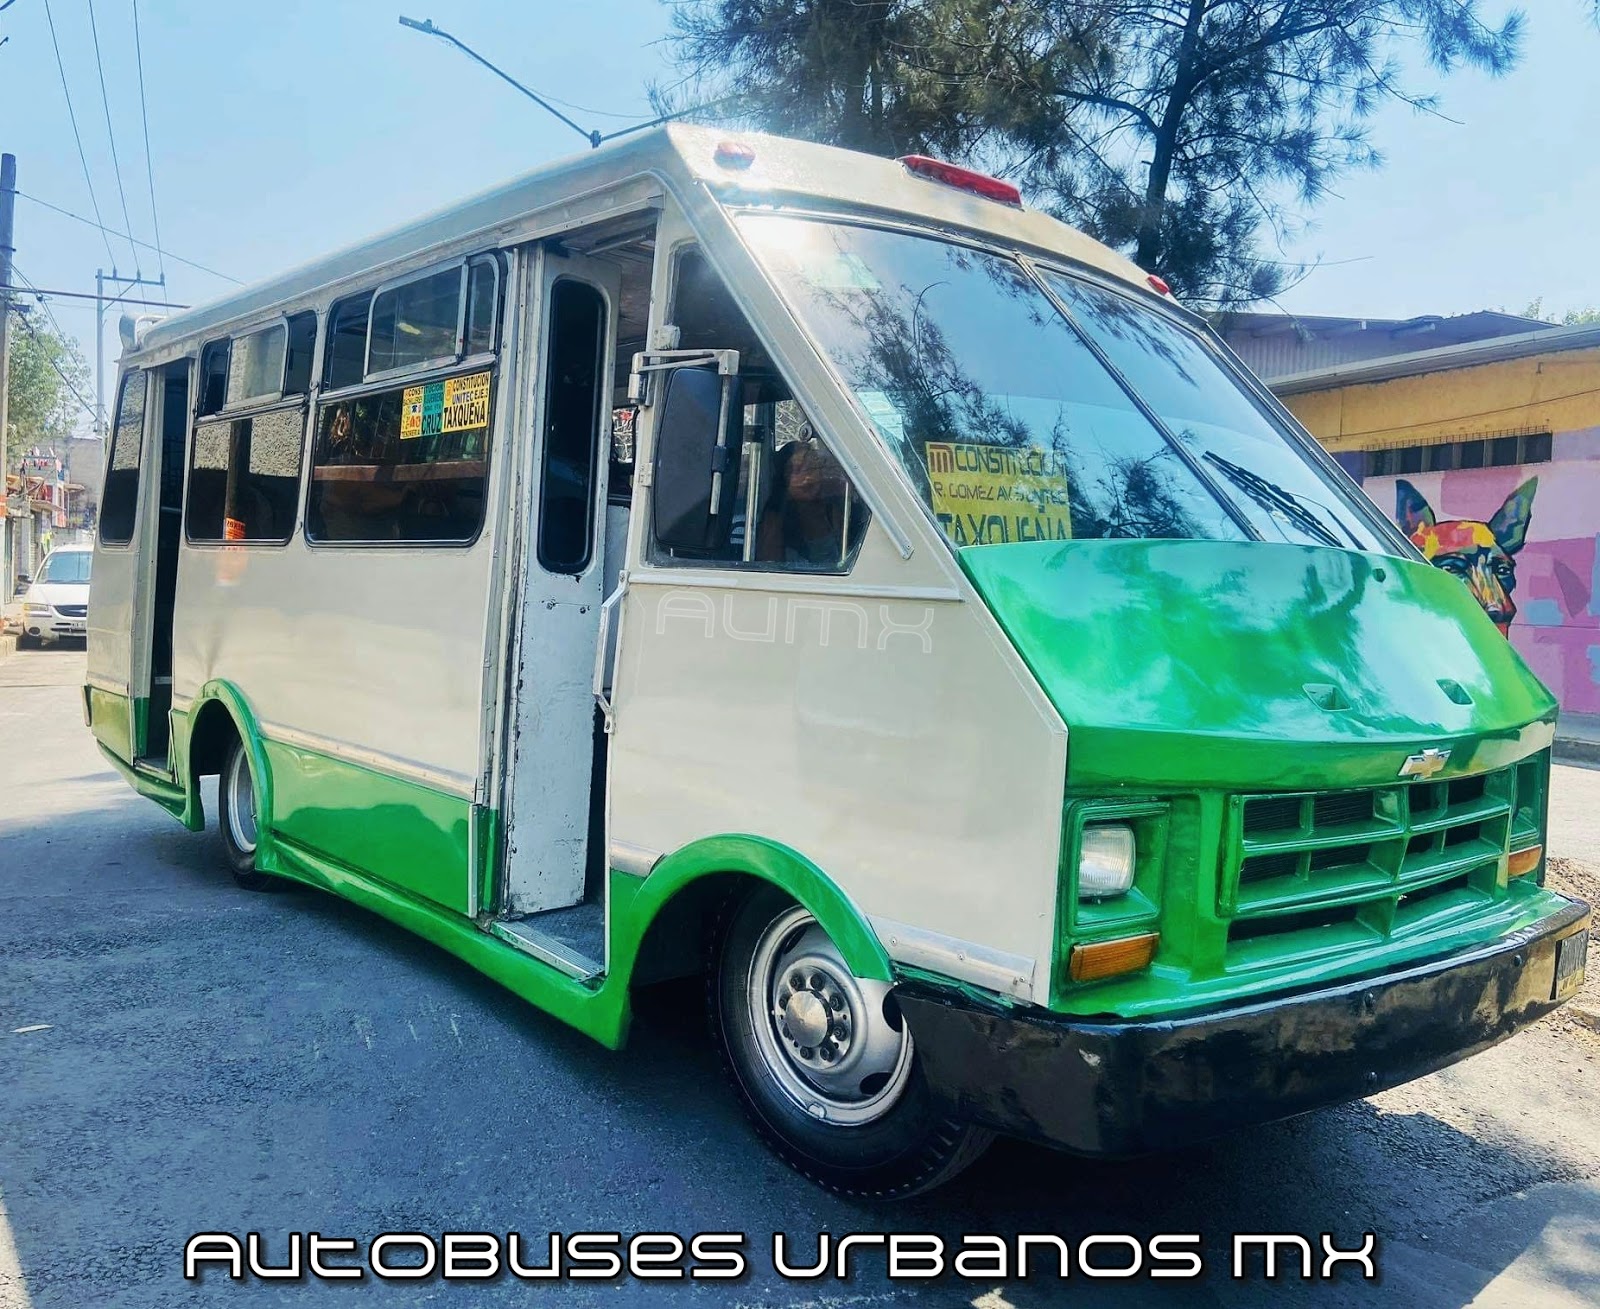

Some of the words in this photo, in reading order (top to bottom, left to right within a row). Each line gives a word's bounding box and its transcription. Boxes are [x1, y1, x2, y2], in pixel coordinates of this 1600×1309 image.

[452, 373, 490, 392] CONSTITUCION
[452, 391, 473, 404] UNITEC
[422, 413, 442, 435] CRUZ
[444, 401, 485, 429] TAXQUEÑA
